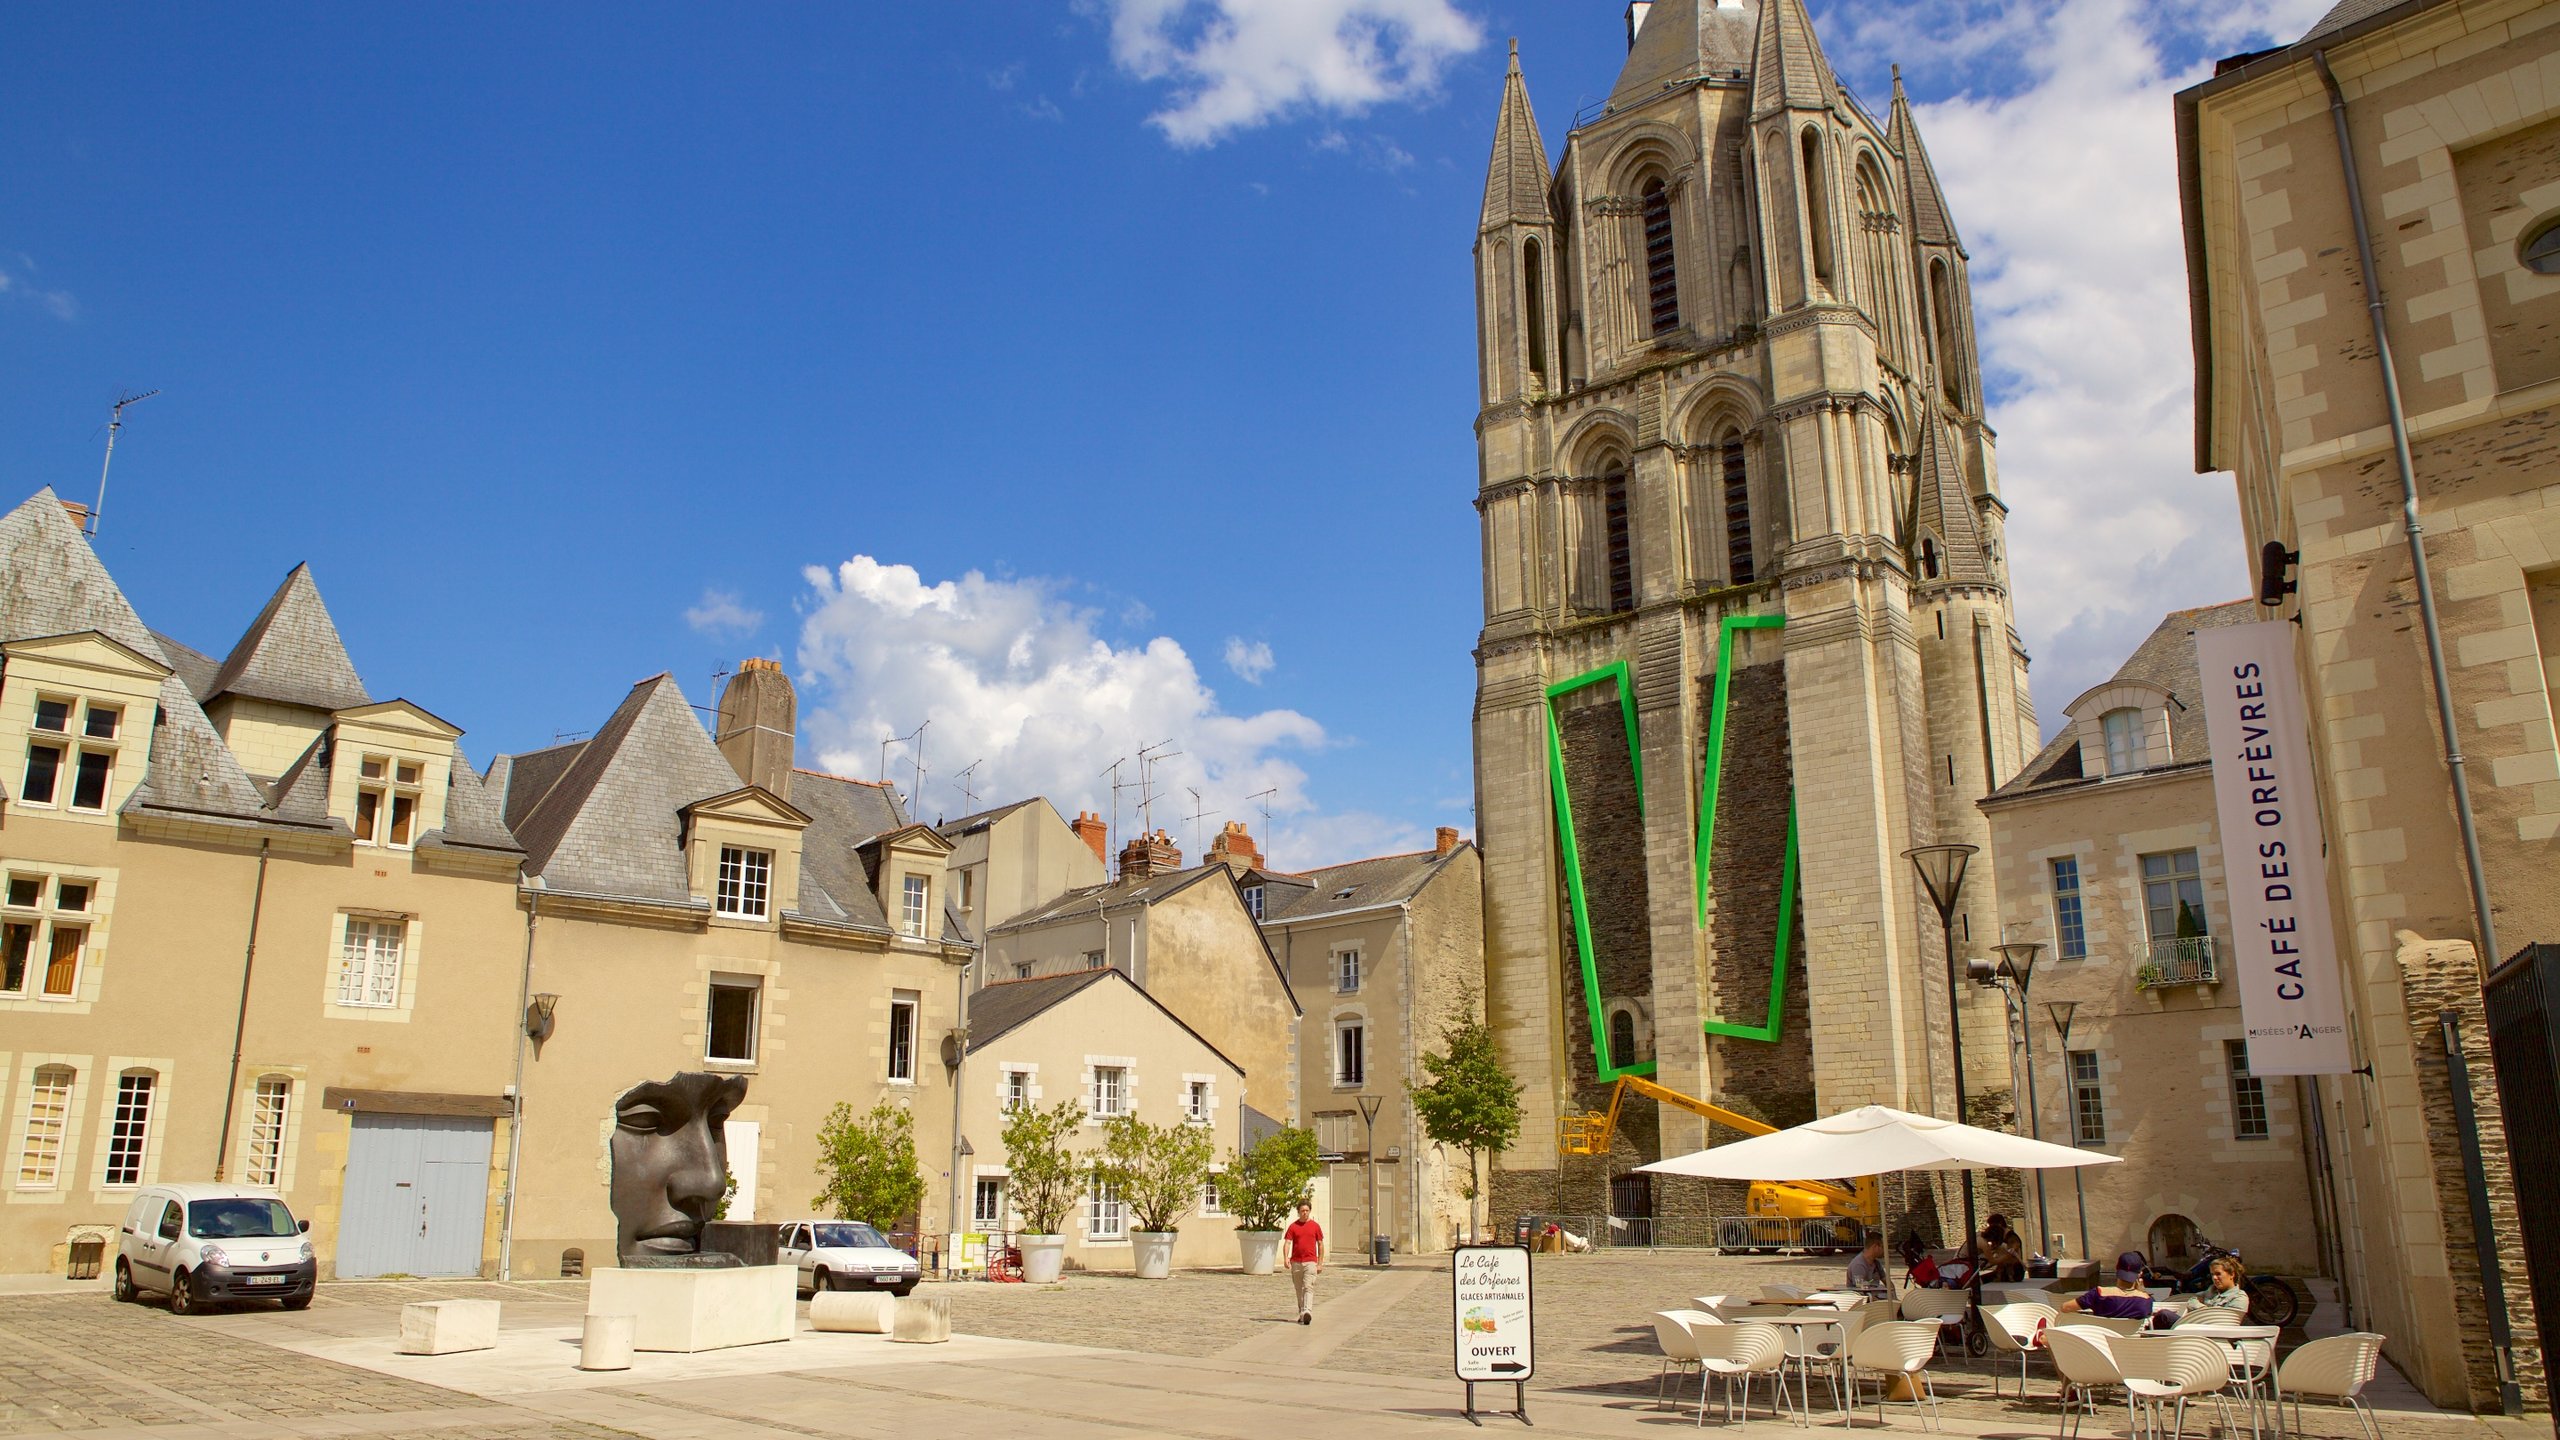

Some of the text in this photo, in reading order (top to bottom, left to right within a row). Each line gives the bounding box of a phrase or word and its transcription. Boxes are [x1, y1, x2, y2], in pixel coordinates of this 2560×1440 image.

[2234, 663, 2304, 1000] CAFÉ DES ORFÈVRES
[1460, 1255, 1499, 1272] Le Café
[1460, 1272, 1520, 1290] des Orfèvres
[1460, 1293, 1525, 1301] GLACES ARTISANALES
[1471, 1346, 1516, 1356] OUVERT
